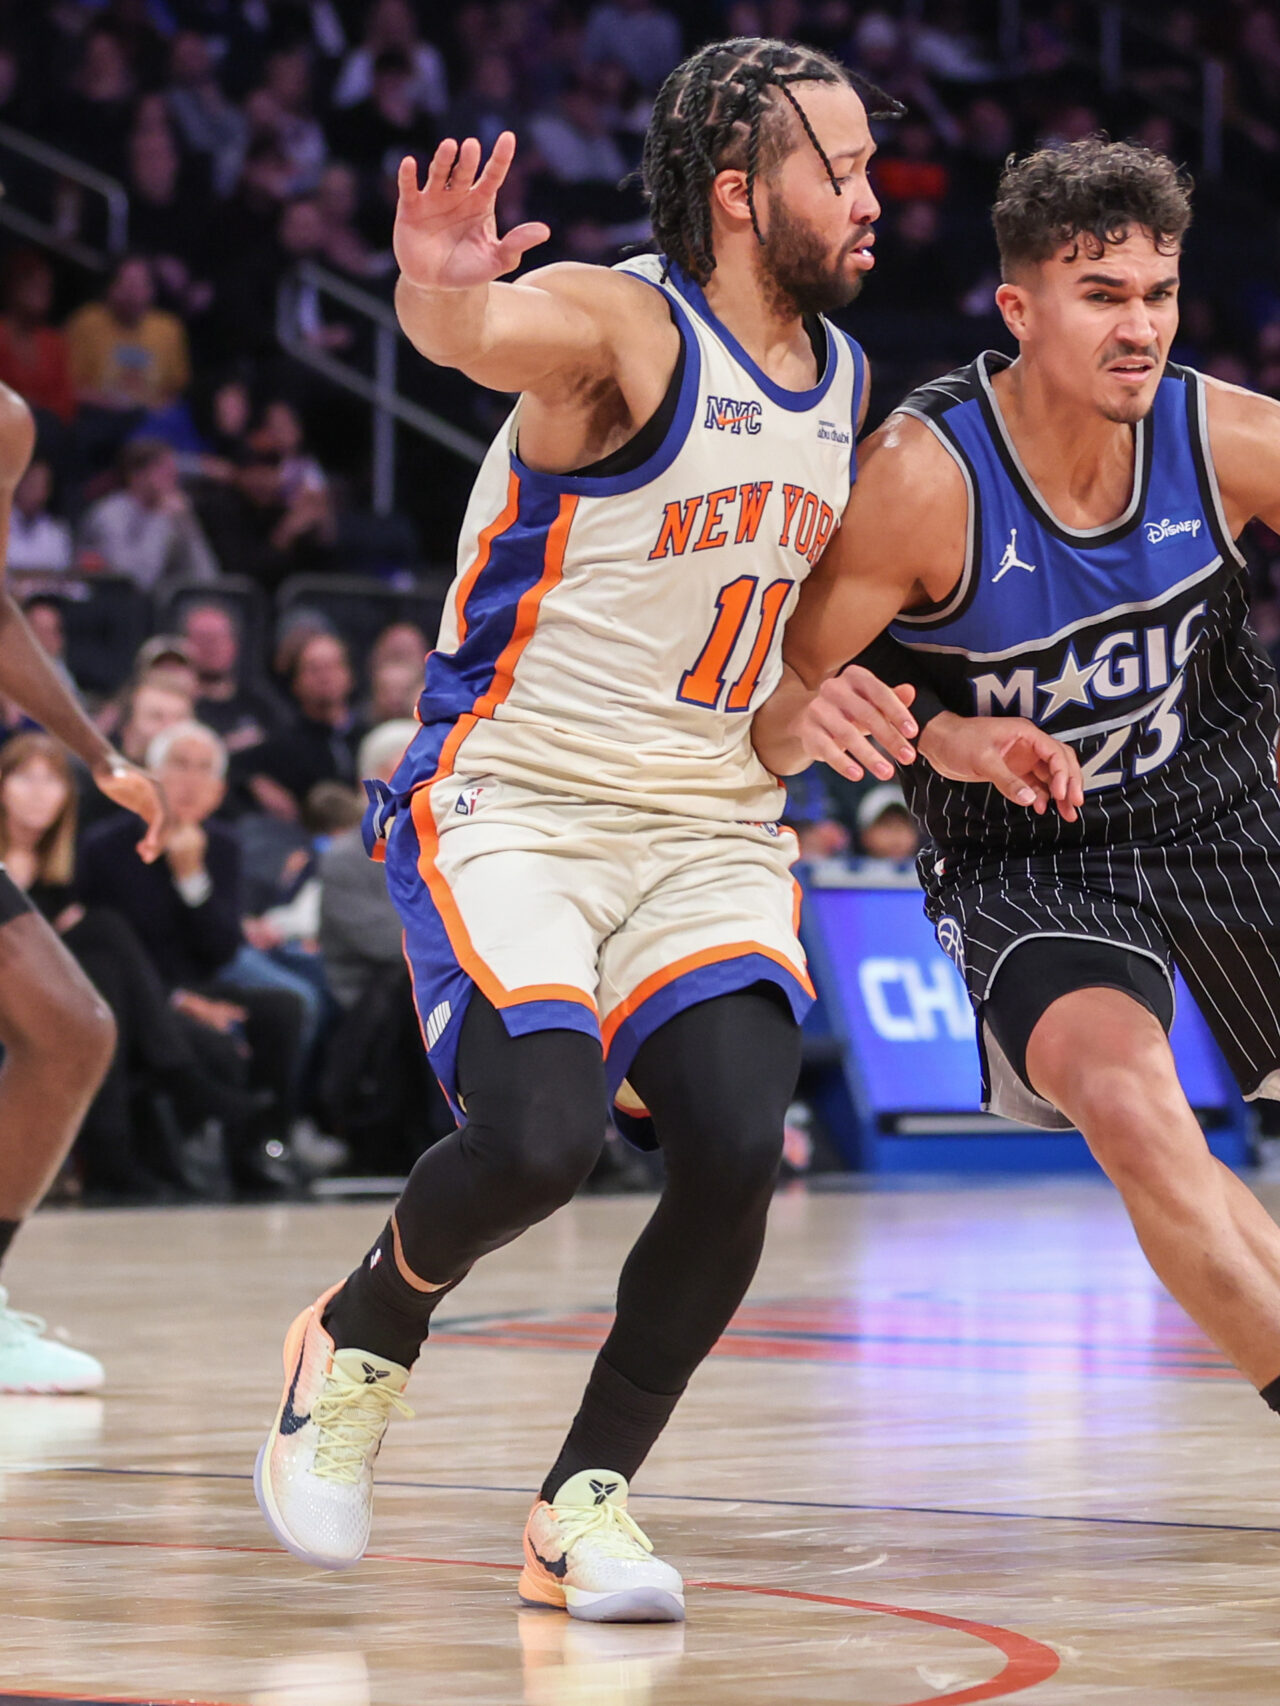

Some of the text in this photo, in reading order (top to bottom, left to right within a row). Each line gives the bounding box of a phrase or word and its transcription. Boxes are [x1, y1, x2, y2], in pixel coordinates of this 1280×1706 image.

[705, 396, 762, 434] NYC
[647, 481, 841, 568] NEW YOR
[676, 574, 795, 713] 11
[1081, 670, 1186, 795] 23
[858, 956, 977, 1041] CH
